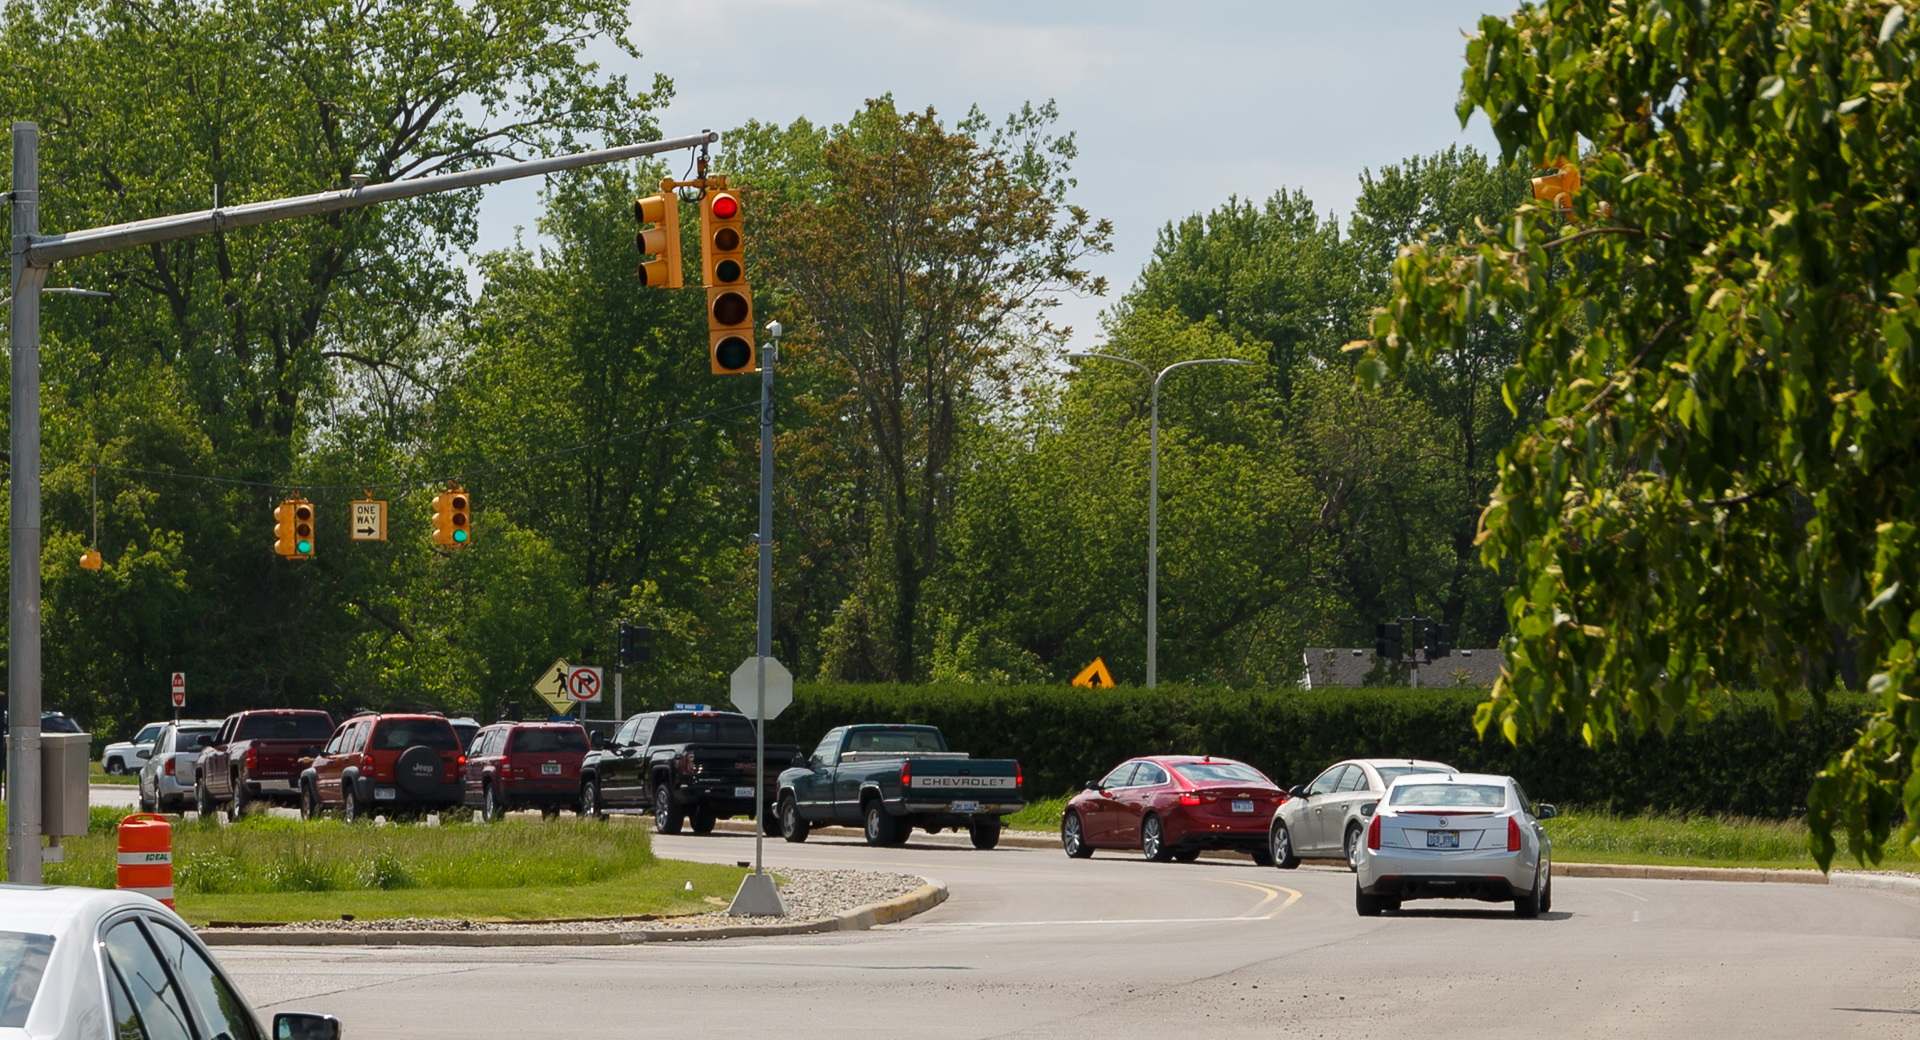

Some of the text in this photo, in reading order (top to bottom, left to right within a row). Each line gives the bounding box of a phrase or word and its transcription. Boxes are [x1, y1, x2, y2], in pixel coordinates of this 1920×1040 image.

[357, 505, 376, 515] ONE
[356, 515, 376, 525] WAY
[412, 762, 434, 773] Jeep
[922, 778, 1006, 786] CHEVROLET
